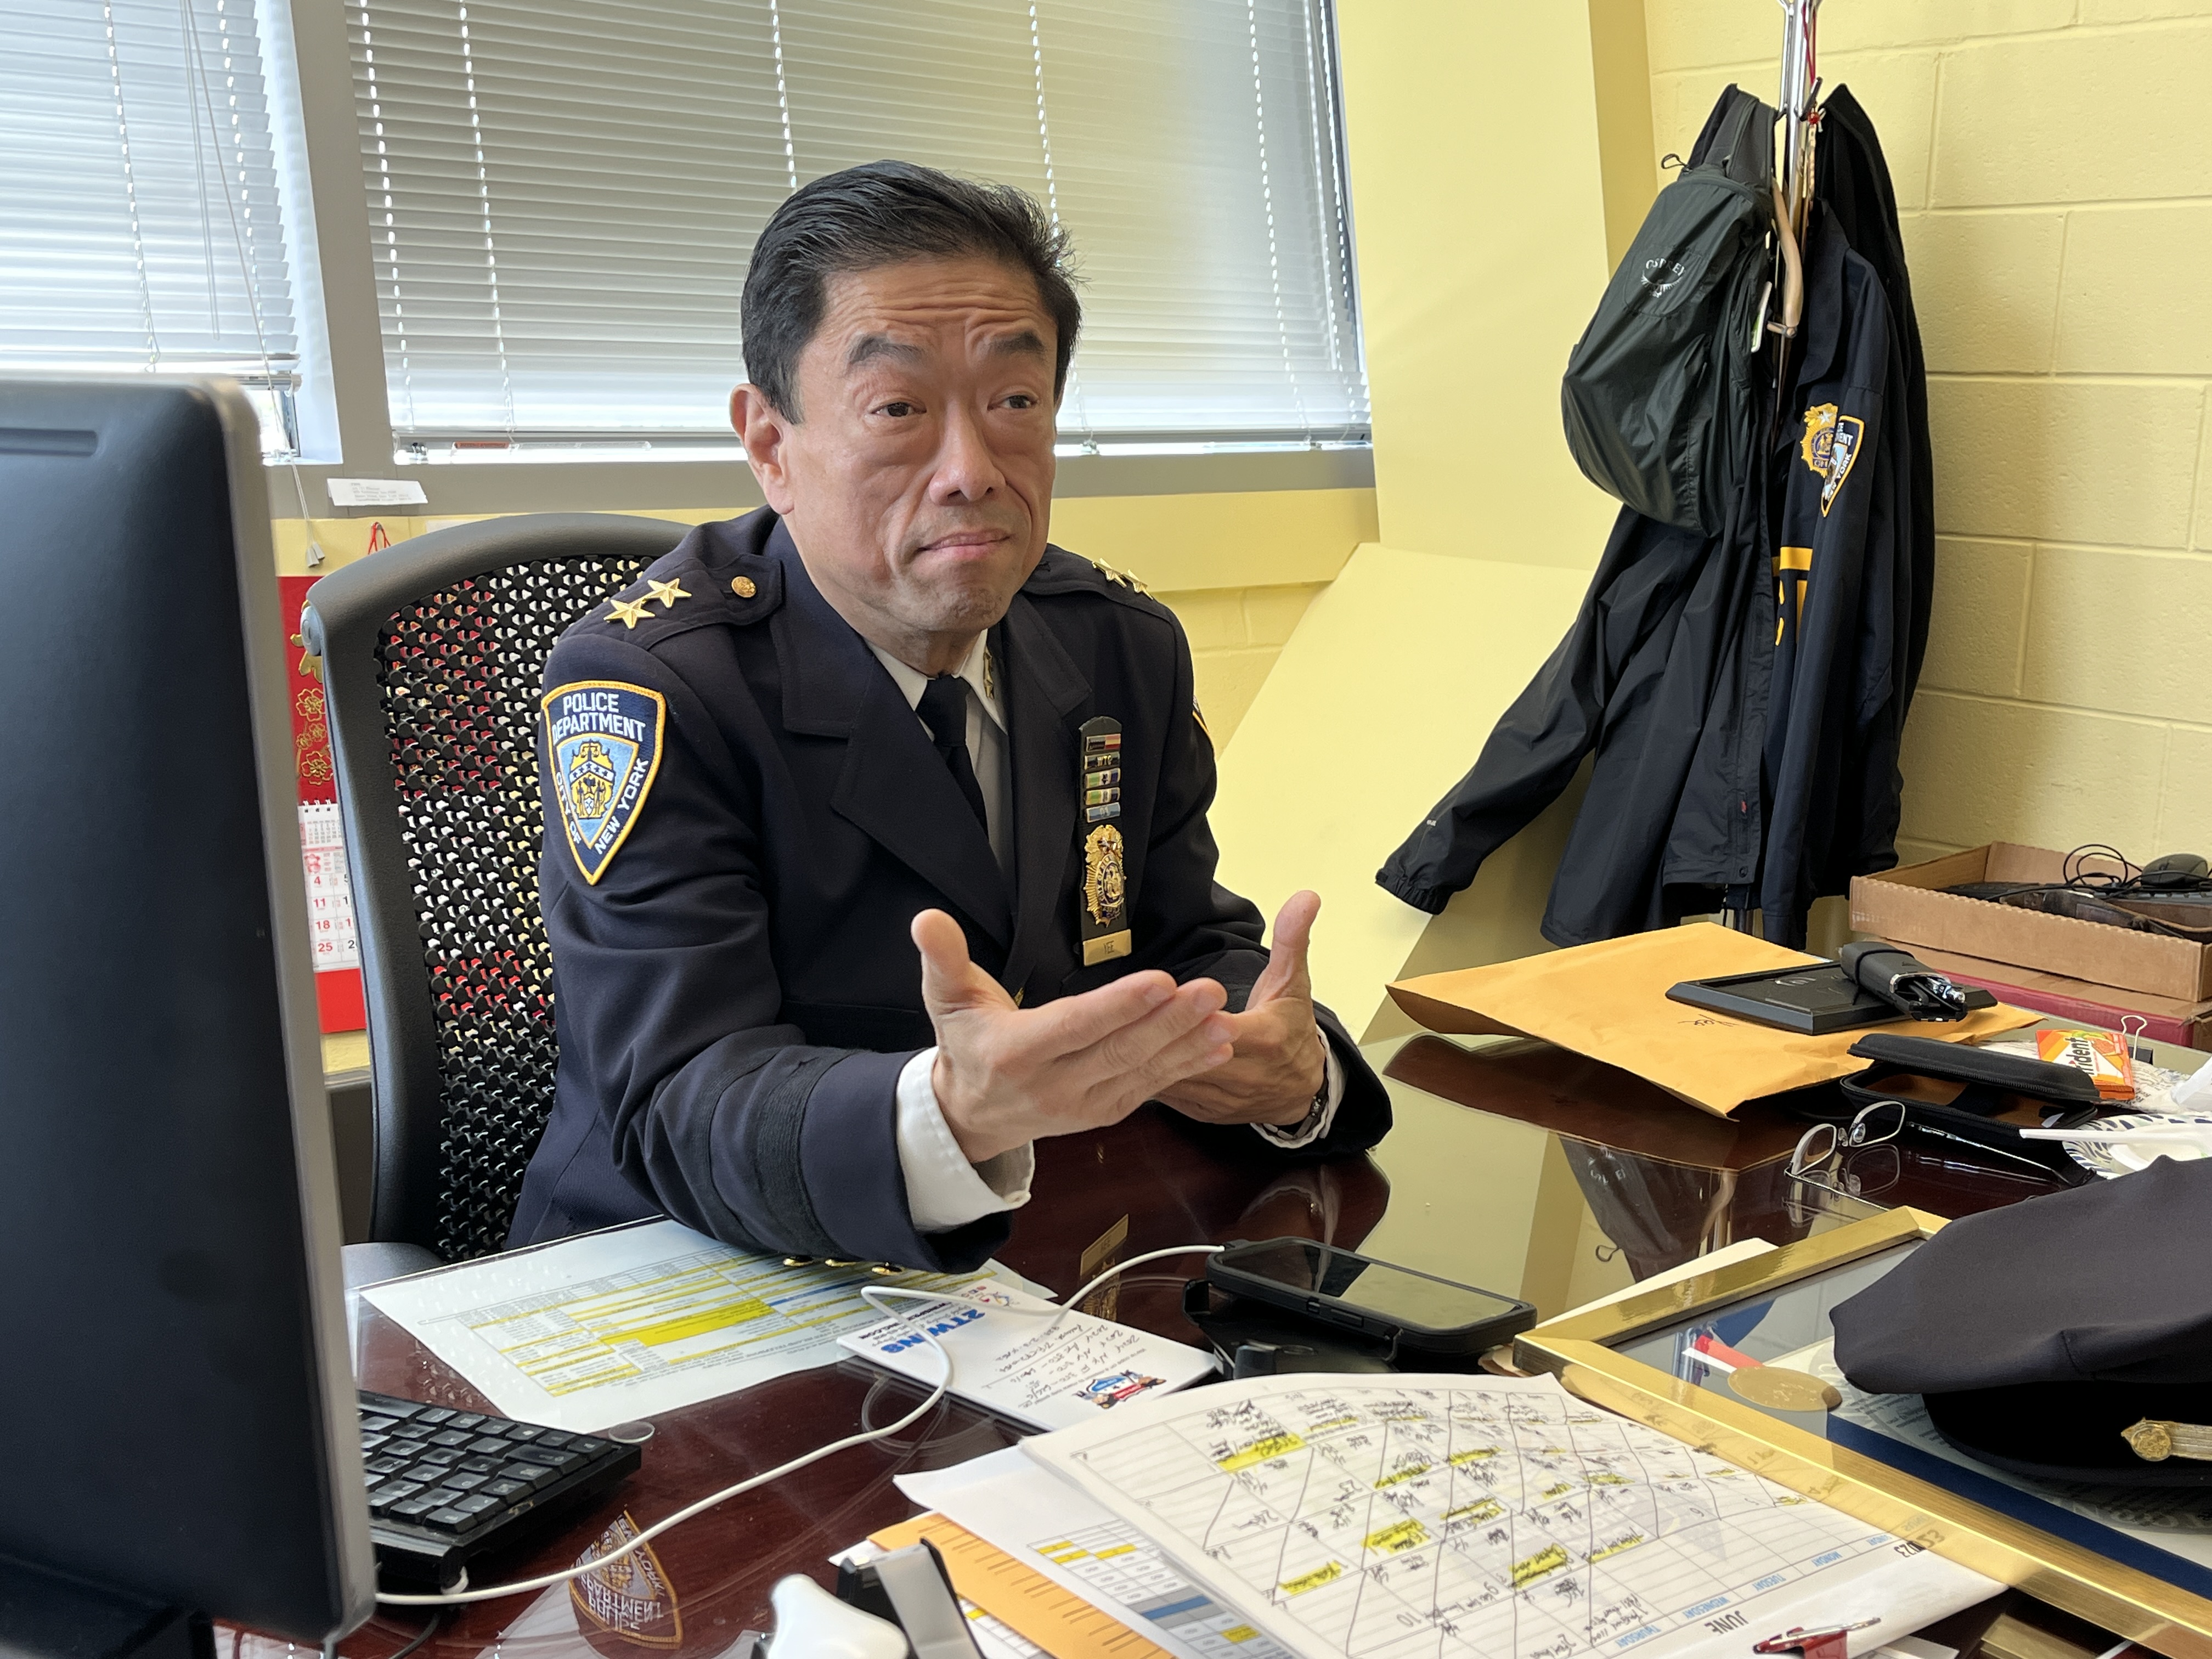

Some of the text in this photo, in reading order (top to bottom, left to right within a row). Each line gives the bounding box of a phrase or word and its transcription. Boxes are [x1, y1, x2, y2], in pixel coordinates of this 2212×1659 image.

[563, 692, 619, 715] POLICE
[552, 712, 646, 746] DEPARTMENT
[594, 758, 649, 855] NEW YORK
[569, 822, 582, 845] OF
[314, 876, 321, 885] 4
[313, 899, 326, 908] 11
[315, 920, 330, 931] 18
[318, 942, 333, 952] 25
[2065, 1037, 2095, 1075] rident
[1690, 1508, 1705, 1517] 6
[1485, 1581, 1499, 1595] 9
[1614, 1534, 1892, 1649] SUNDAY MONDAY TUESDAY WEDNESDAY THURSDAY
[1396, 1611, 1421, 1627] 10
[1704, 1610, 1749, 1636] JUNE
